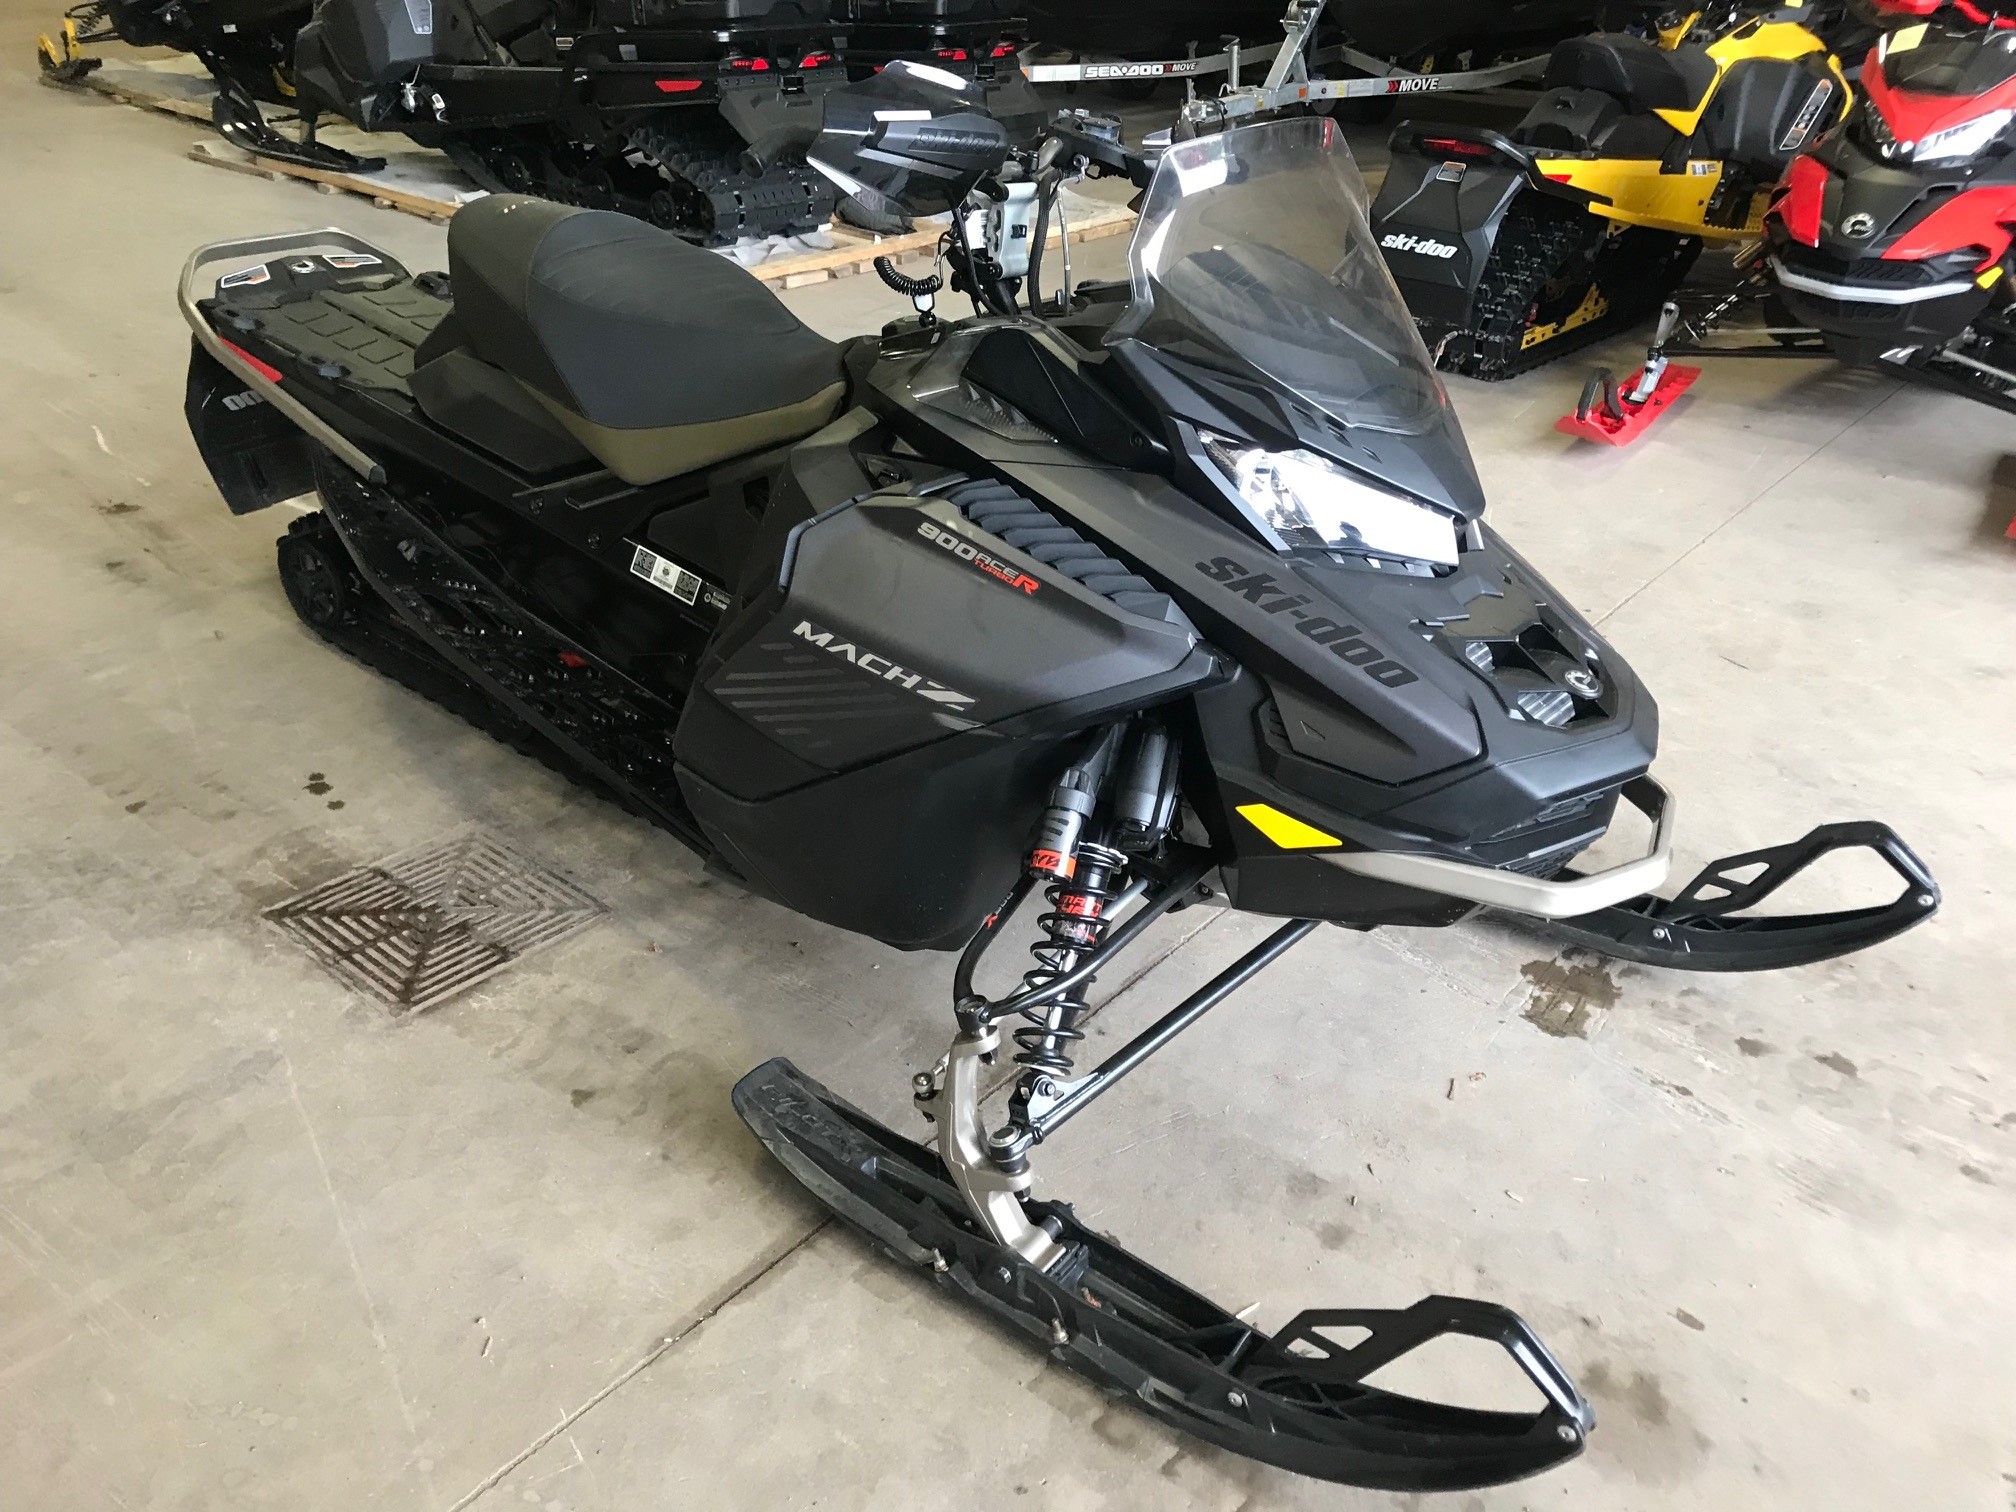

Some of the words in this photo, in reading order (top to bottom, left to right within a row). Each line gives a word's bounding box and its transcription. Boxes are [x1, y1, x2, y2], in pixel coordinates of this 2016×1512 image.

[1171, 62, 1197, 72] MOVE
[1398, 77, 1439, 92] MOVE
[1380, 233, 1458, 259] ski-doo
[917, 522, 979, 561] 900
[976, 552, 1019, 579] ACE
[973, 558, 1014, 584] TURBO
[1012, 574, 1040, 595] R
[1195, 556, 1419, 688] ski-doo
